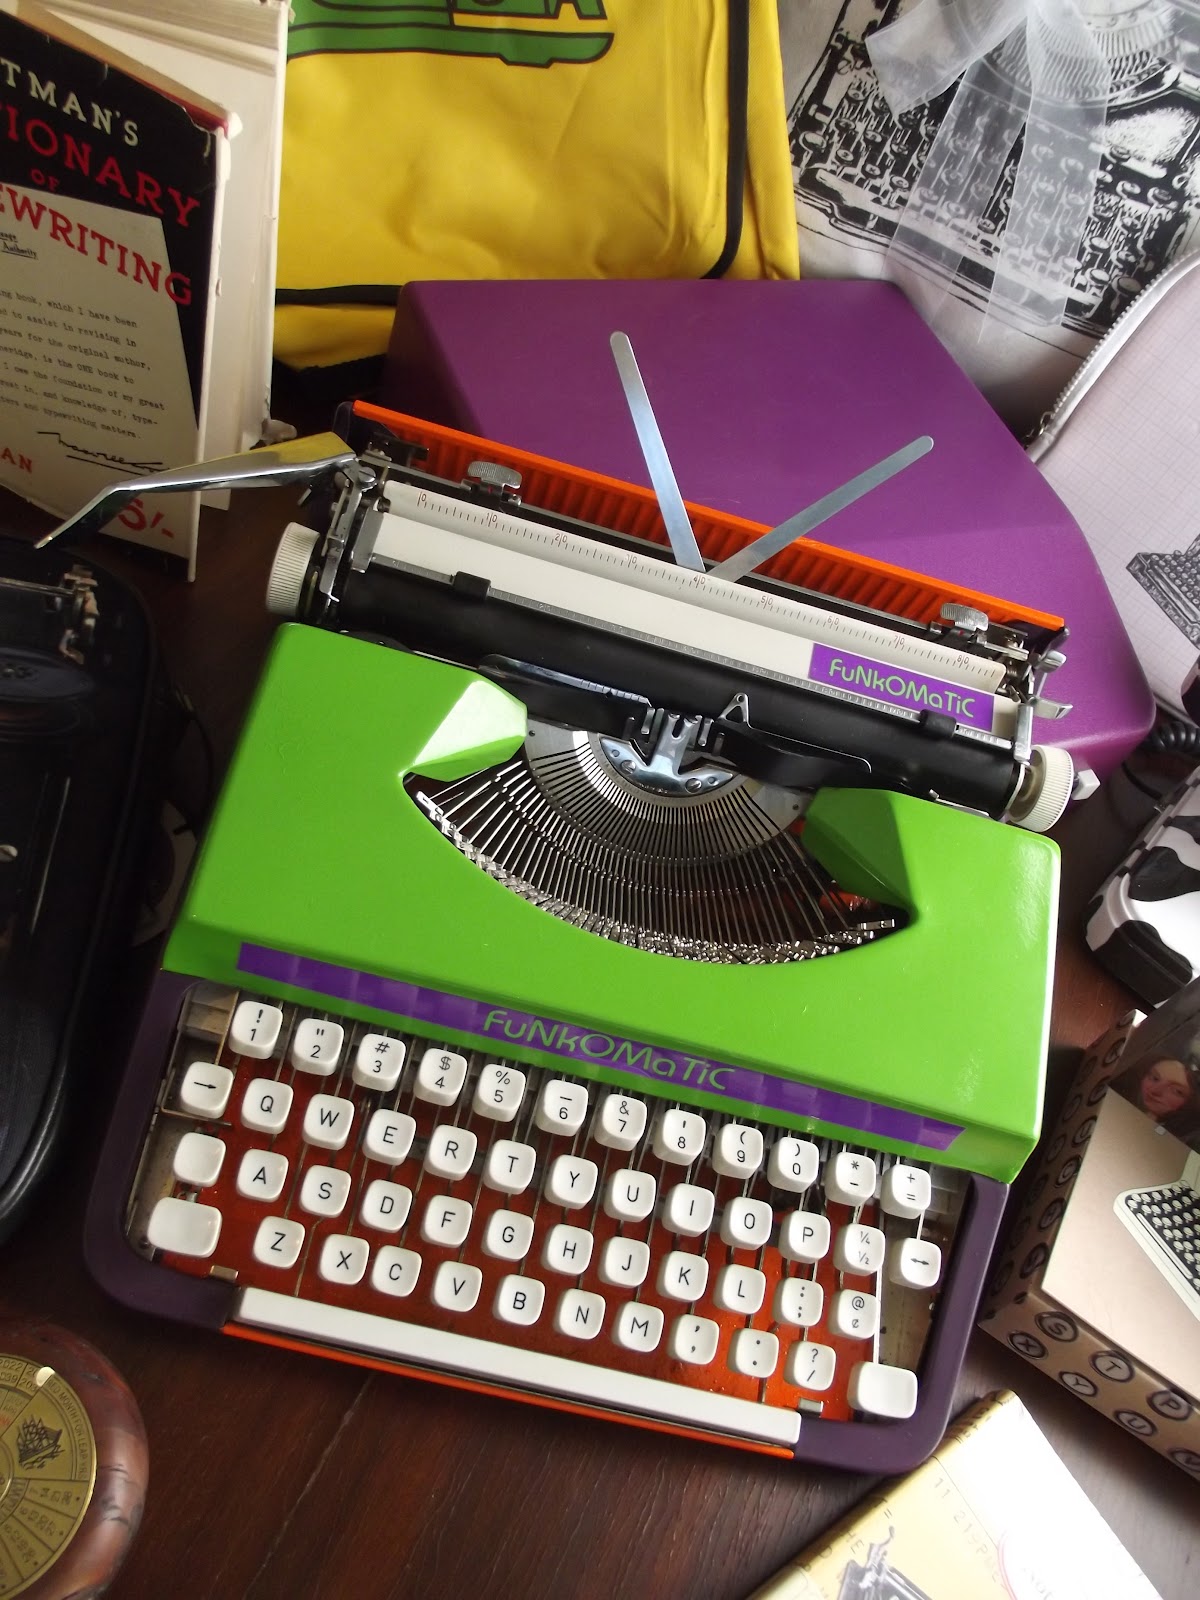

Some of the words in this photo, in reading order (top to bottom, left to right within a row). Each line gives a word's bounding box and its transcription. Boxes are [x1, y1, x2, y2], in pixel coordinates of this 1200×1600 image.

[0, 103, 200, 228] IONARY
[31, 168, 60, 191] OF
[47, 301, 74, 313] which
[88, 310, 110, 321] have
[114, 315, 137, 328] been
[12, 311, 22, 320] to
[62, 322, 74, 332] in
[78, 328, 121, 345] revising
[126, 338, 137, 348] in
[28, 332, 43, 343] for
[48, 338, 63, 348] the
[67, 344, 110, 360] original
[114, 355, 151, 371] author,
[57, 359, 73, 369] the
[77, 363, 94, 374] ONE
[97, 368, 120, 381] book
[124, 375, 135, 385] to
[33, 370, 48, 380] the
[53, 375, 103, 395] foundation
[107, 390, 118, 399] of
[139, 398, 165, 412] great
[250, 1028, 257, 1042] 1
[310, 1044, 321, 1059] 2
[372, 1059, 383, 1074] 3
[434, 1076, 445, 1089] 4
[260, 1095, 274, 1114] Q
[493, 1089, 504, 1103] 5
[320, 1108, 340, 1128] W
[559, 1106, 568, 1120] 6
[382, 1125, 398, 1144] E
[618, 1118, 627, 1133] 7
[444, 1140, 459, 1160] R
[677, 1136, 686, 1149] 8
[507, 1155, 519, 1173] T
[736, 1149, 746, 1163] 9
[252, 1166, 267, 1185] A
[792, 1162, 801, 1176] 0
[569, 1170, 581, 1188] Y
[318, 1182, 333, 1200] S
[626, 1184, 640, 1203] U
[379, 1195, 395, 1215] D
[441, 1210, 456, 1228] F
[744, 1212, 756, 1230] O
[270, 1231, 287, 1252] Z
[502, 1225, 515, 1244] G
[802, 1226, 814, 1243] P
[562, 1240, 577, 1260] H
[336, 1250, 353, 1270] X
[621, 1254, 633, 1271] J
[388, 1263, 403, 1281] C
[678, 1266, 691, 1286] K
[453, 1277, 466, 1296] V
[737, 1279, 746, 1298] L
[512, 1291, 527, 1311] B
[575, 1305, 590, 1325] N
[630, 1316, 650, 1338] M
[1049, 1321, 1068, 1336] S
[1018, 1338, 1037, 1352] X
[1106, 1360, 1122, 1372] T
[1073, 1376, 1090, 1388] Y
[1159, 1399, 1181, 1411] P
